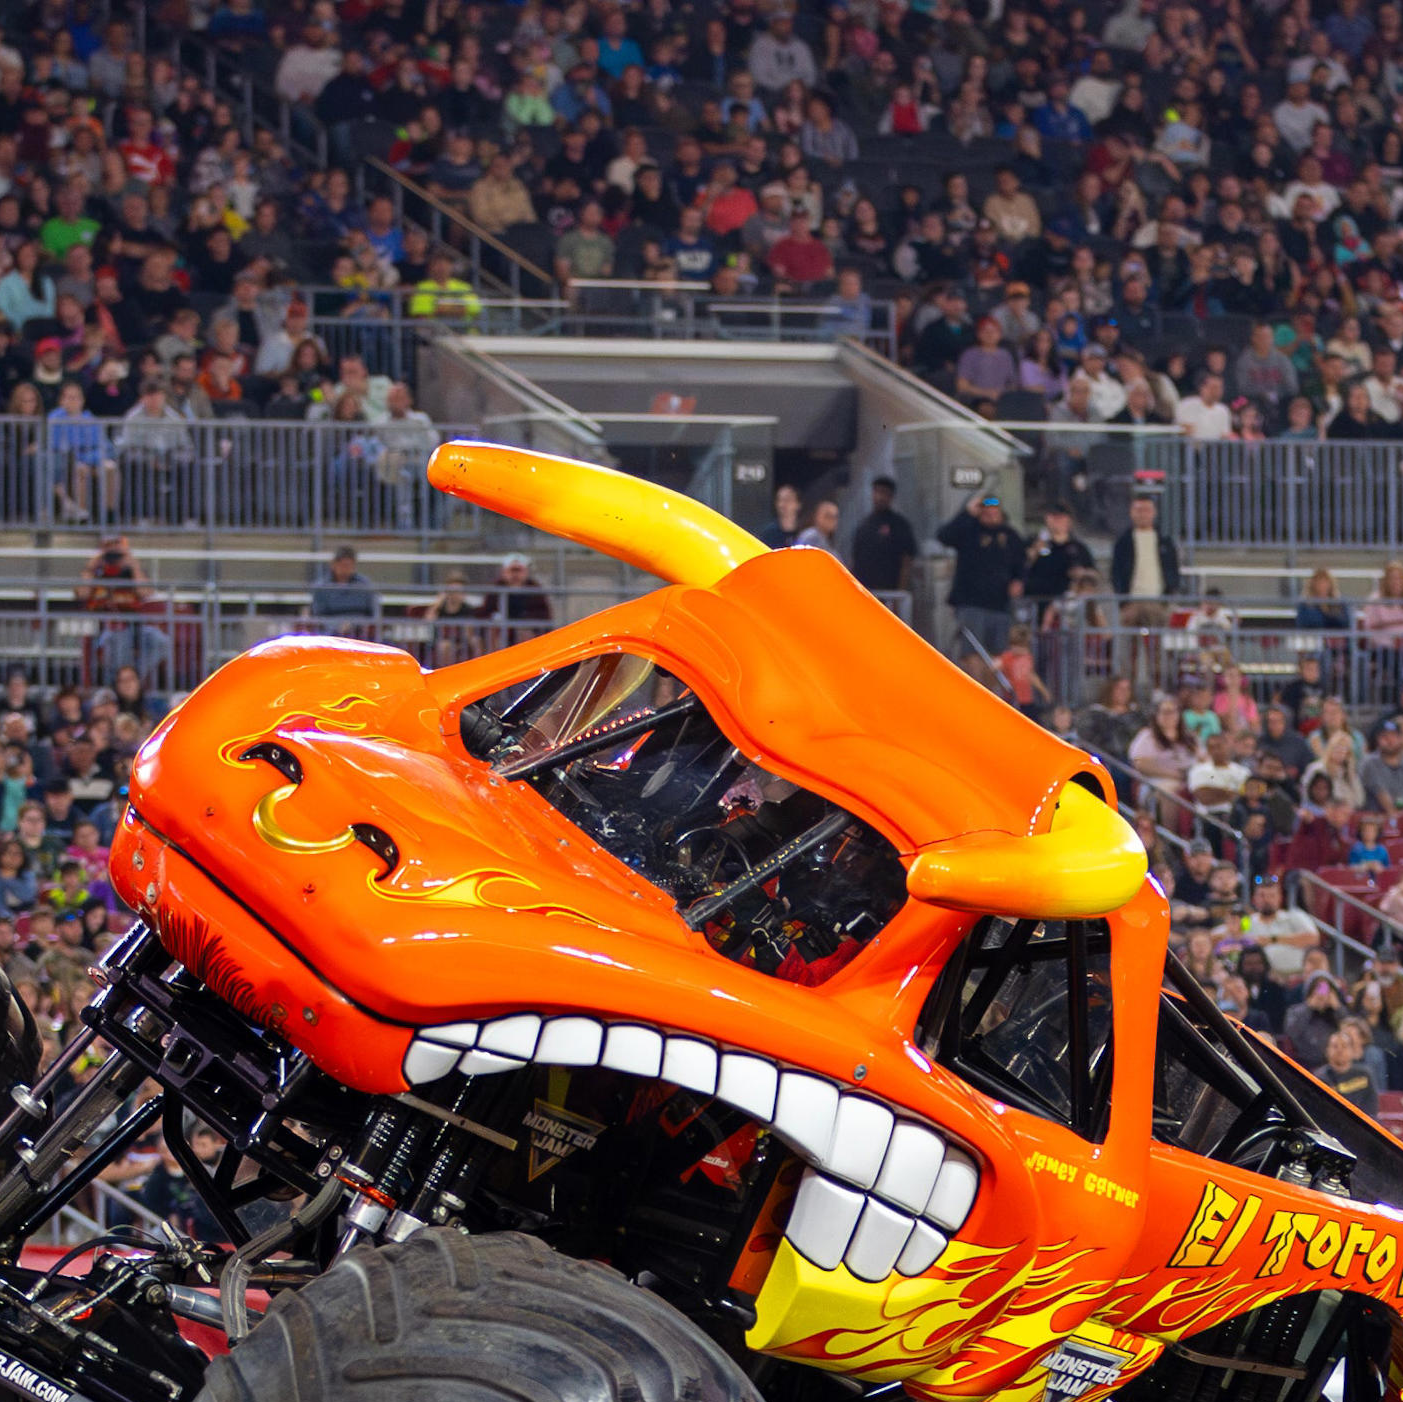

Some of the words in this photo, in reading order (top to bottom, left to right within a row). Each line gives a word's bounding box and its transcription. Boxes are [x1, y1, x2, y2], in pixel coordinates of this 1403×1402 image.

[522, 1111, 598, 1152] MONSTER
[534, 1135, 570, 1158] JAM
[1040, 1352, 1122, 1387] MONSTER
[1046, 1373, 1090, 1397] JAM
